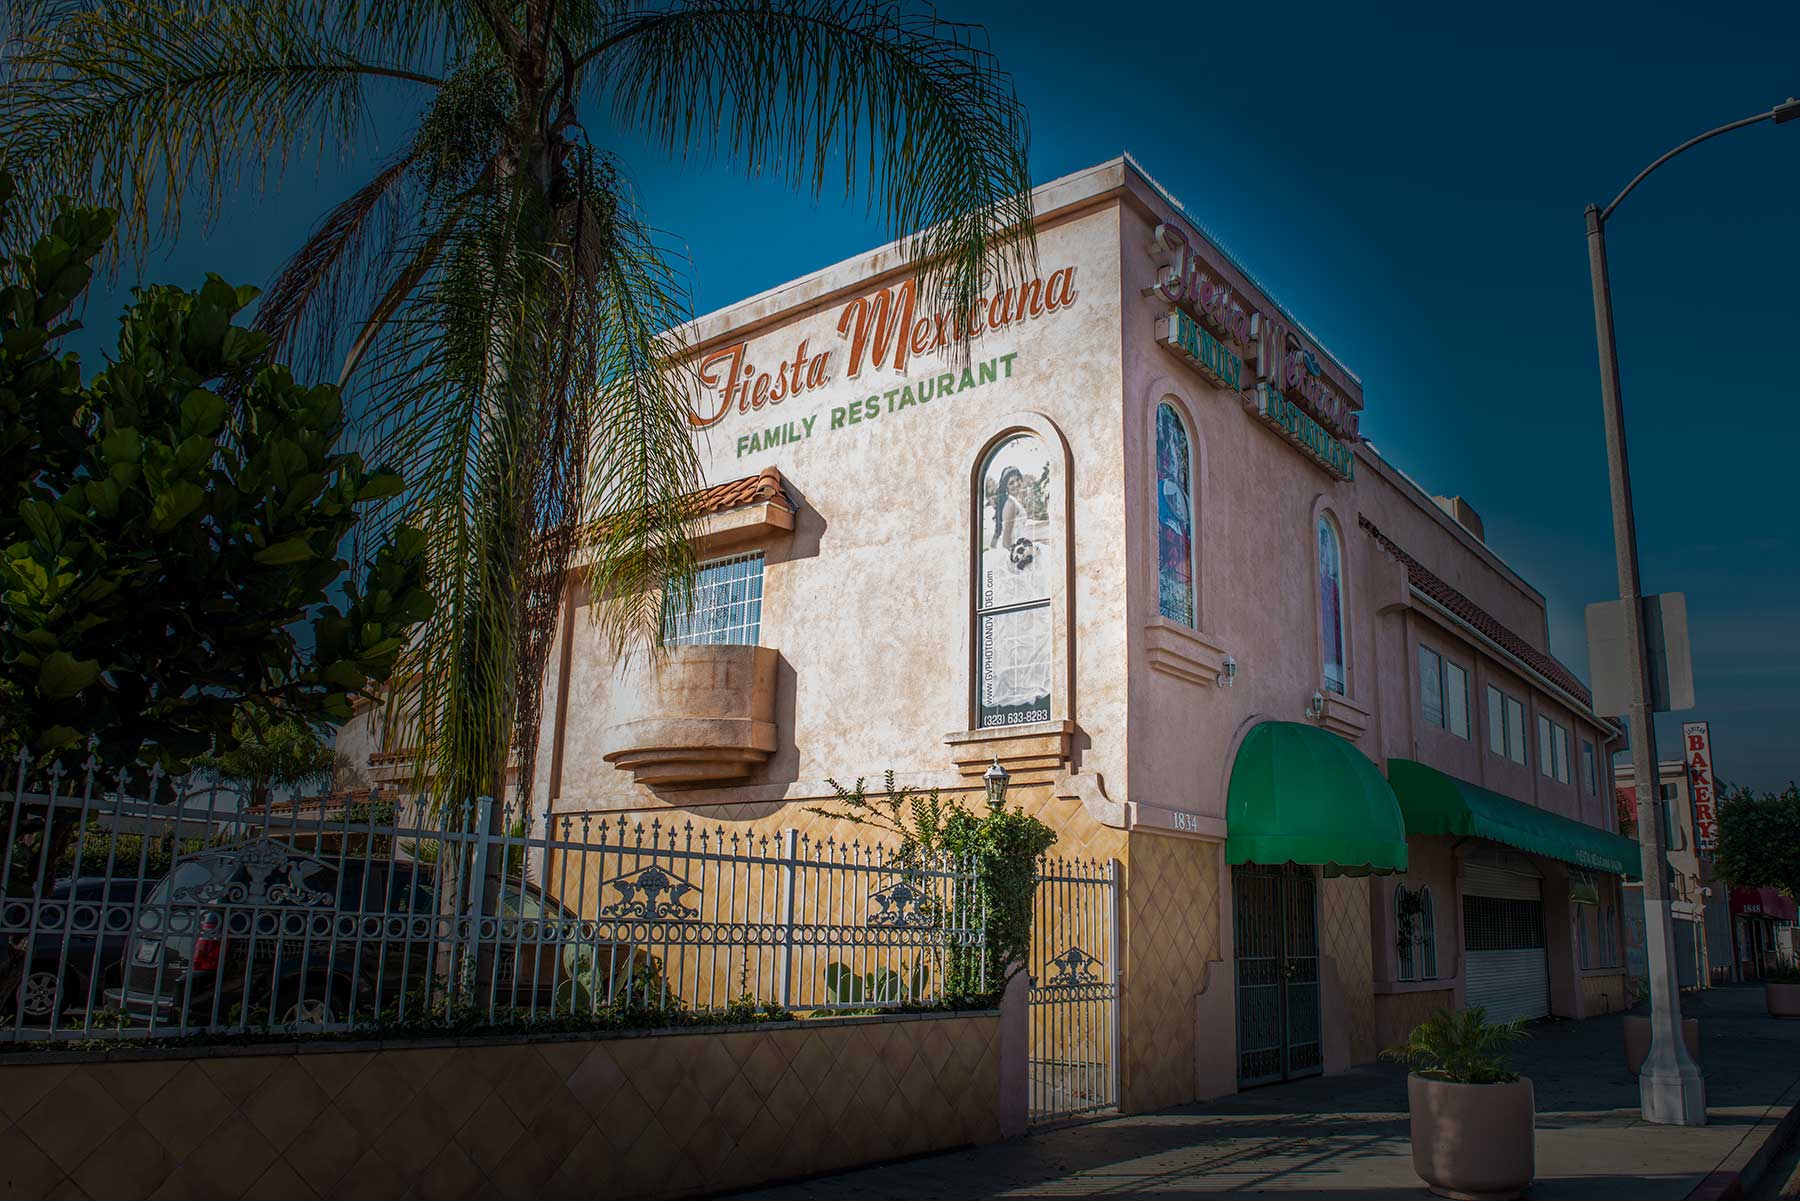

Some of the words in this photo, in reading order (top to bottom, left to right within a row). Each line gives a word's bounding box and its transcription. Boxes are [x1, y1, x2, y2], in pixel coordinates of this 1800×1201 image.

[688, 338, 830, 430] Fiesta
[837, 265, 1078, 376] Mexicana
[1168, 306, 1242, 392] FAMILY
[1258, 382, 1354, 481] RESTAURANT
[736, 414, 817, 458] FAMILY
[830, 351, 1018, 431] RESTAURANT
[984, 570, 994, 705] www.GVPHOTOANDVDEO.com
[983, 714, 1006, 727] (323)
[1007, 709, 1048, 725] 633-8283
[1174, 811, 1198, 833] 1834
[1688, 735, 1713, 838] BAKERY
